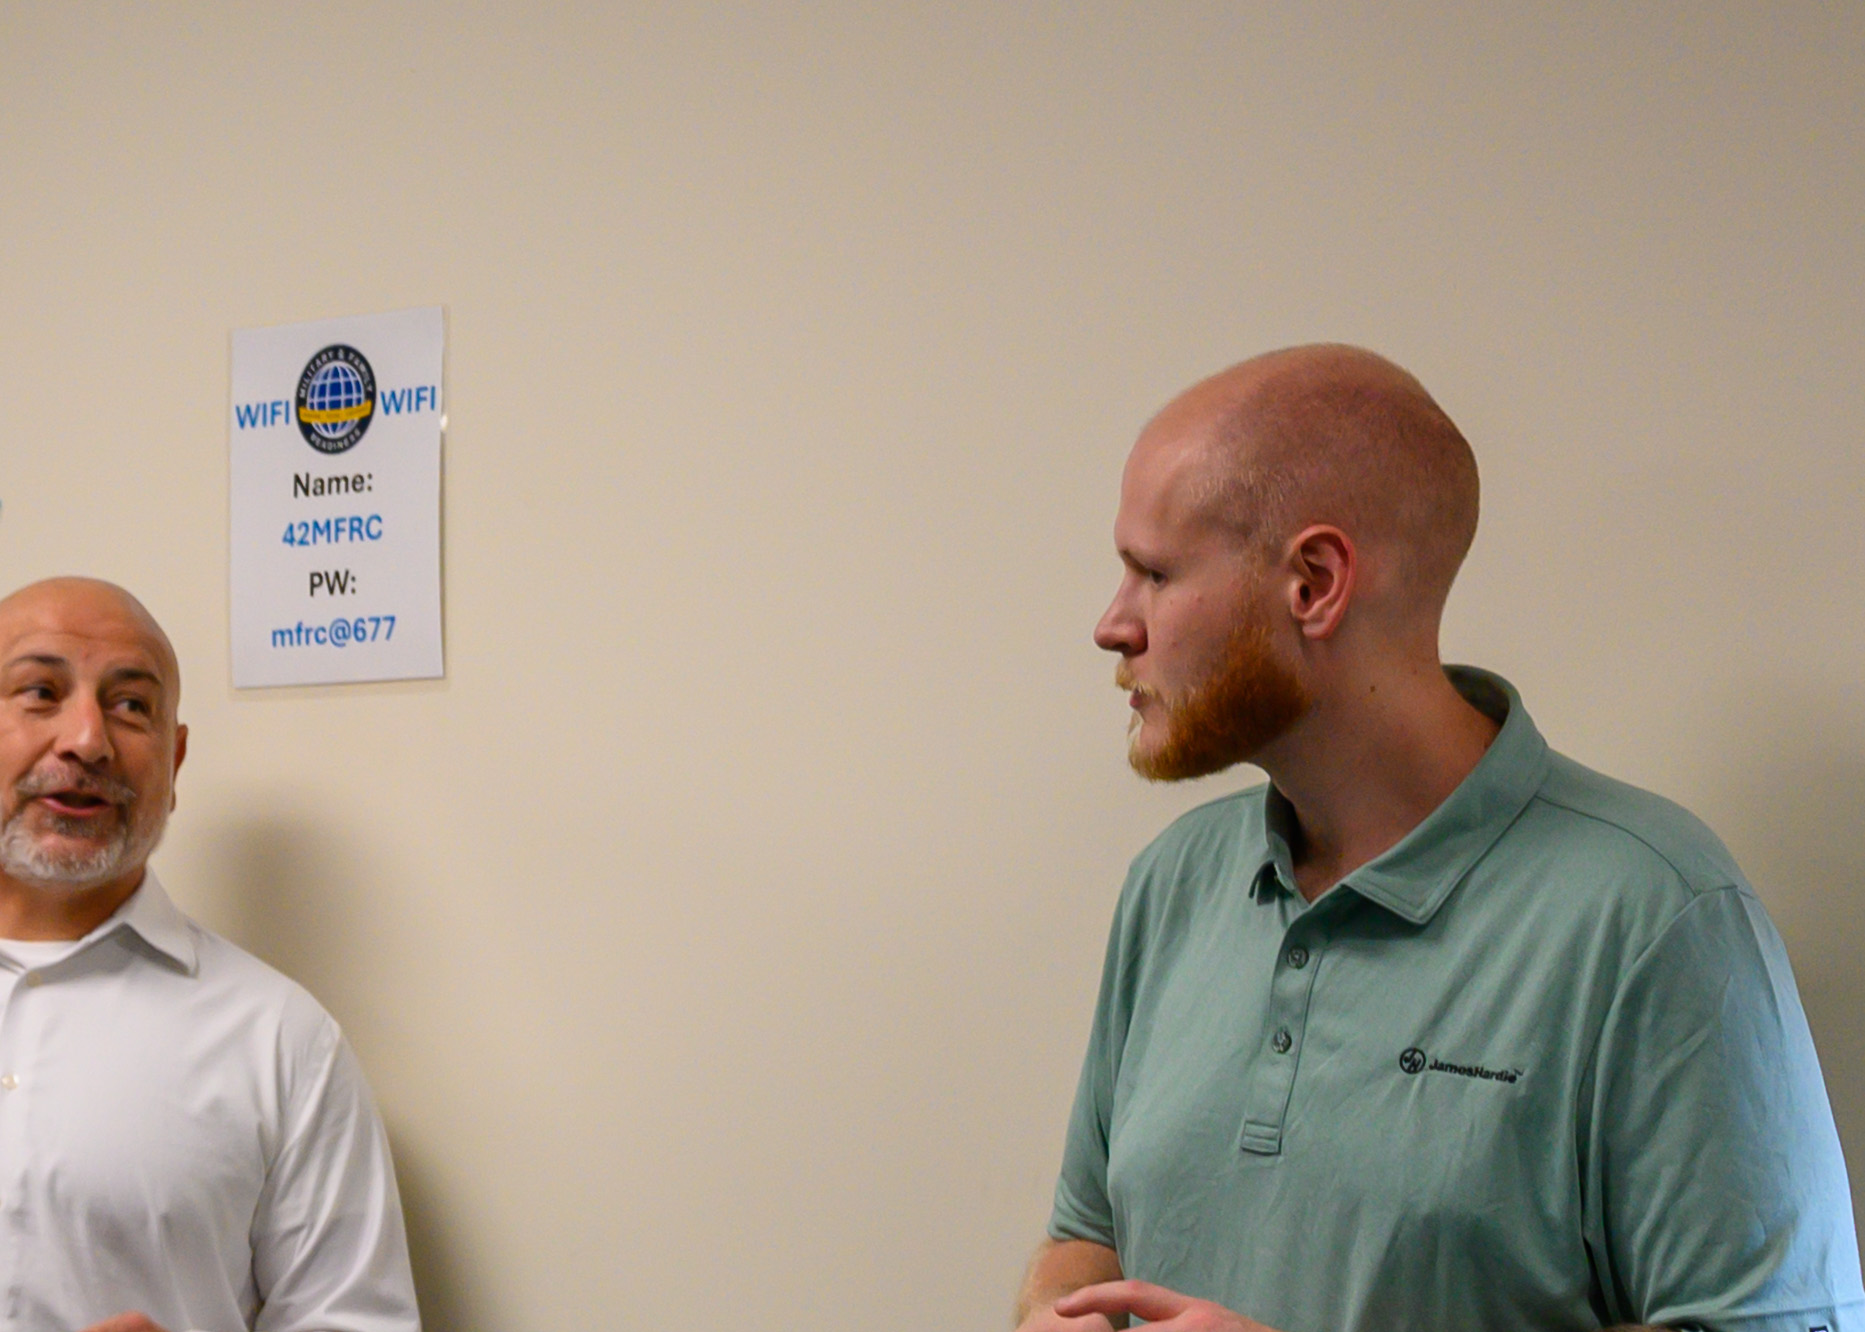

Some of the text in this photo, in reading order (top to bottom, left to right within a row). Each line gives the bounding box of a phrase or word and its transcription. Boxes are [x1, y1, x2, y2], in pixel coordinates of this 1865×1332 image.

[236, 400, 290, 430] WIFI
[380, 386, 436, 416] WIFI
[293, 472, 373, 498] Name:
[282, 514, 383, 547] 42MFRC
[309, 569, 357, 597] PW:
[271, 616, 396, 648] mfrc@677
